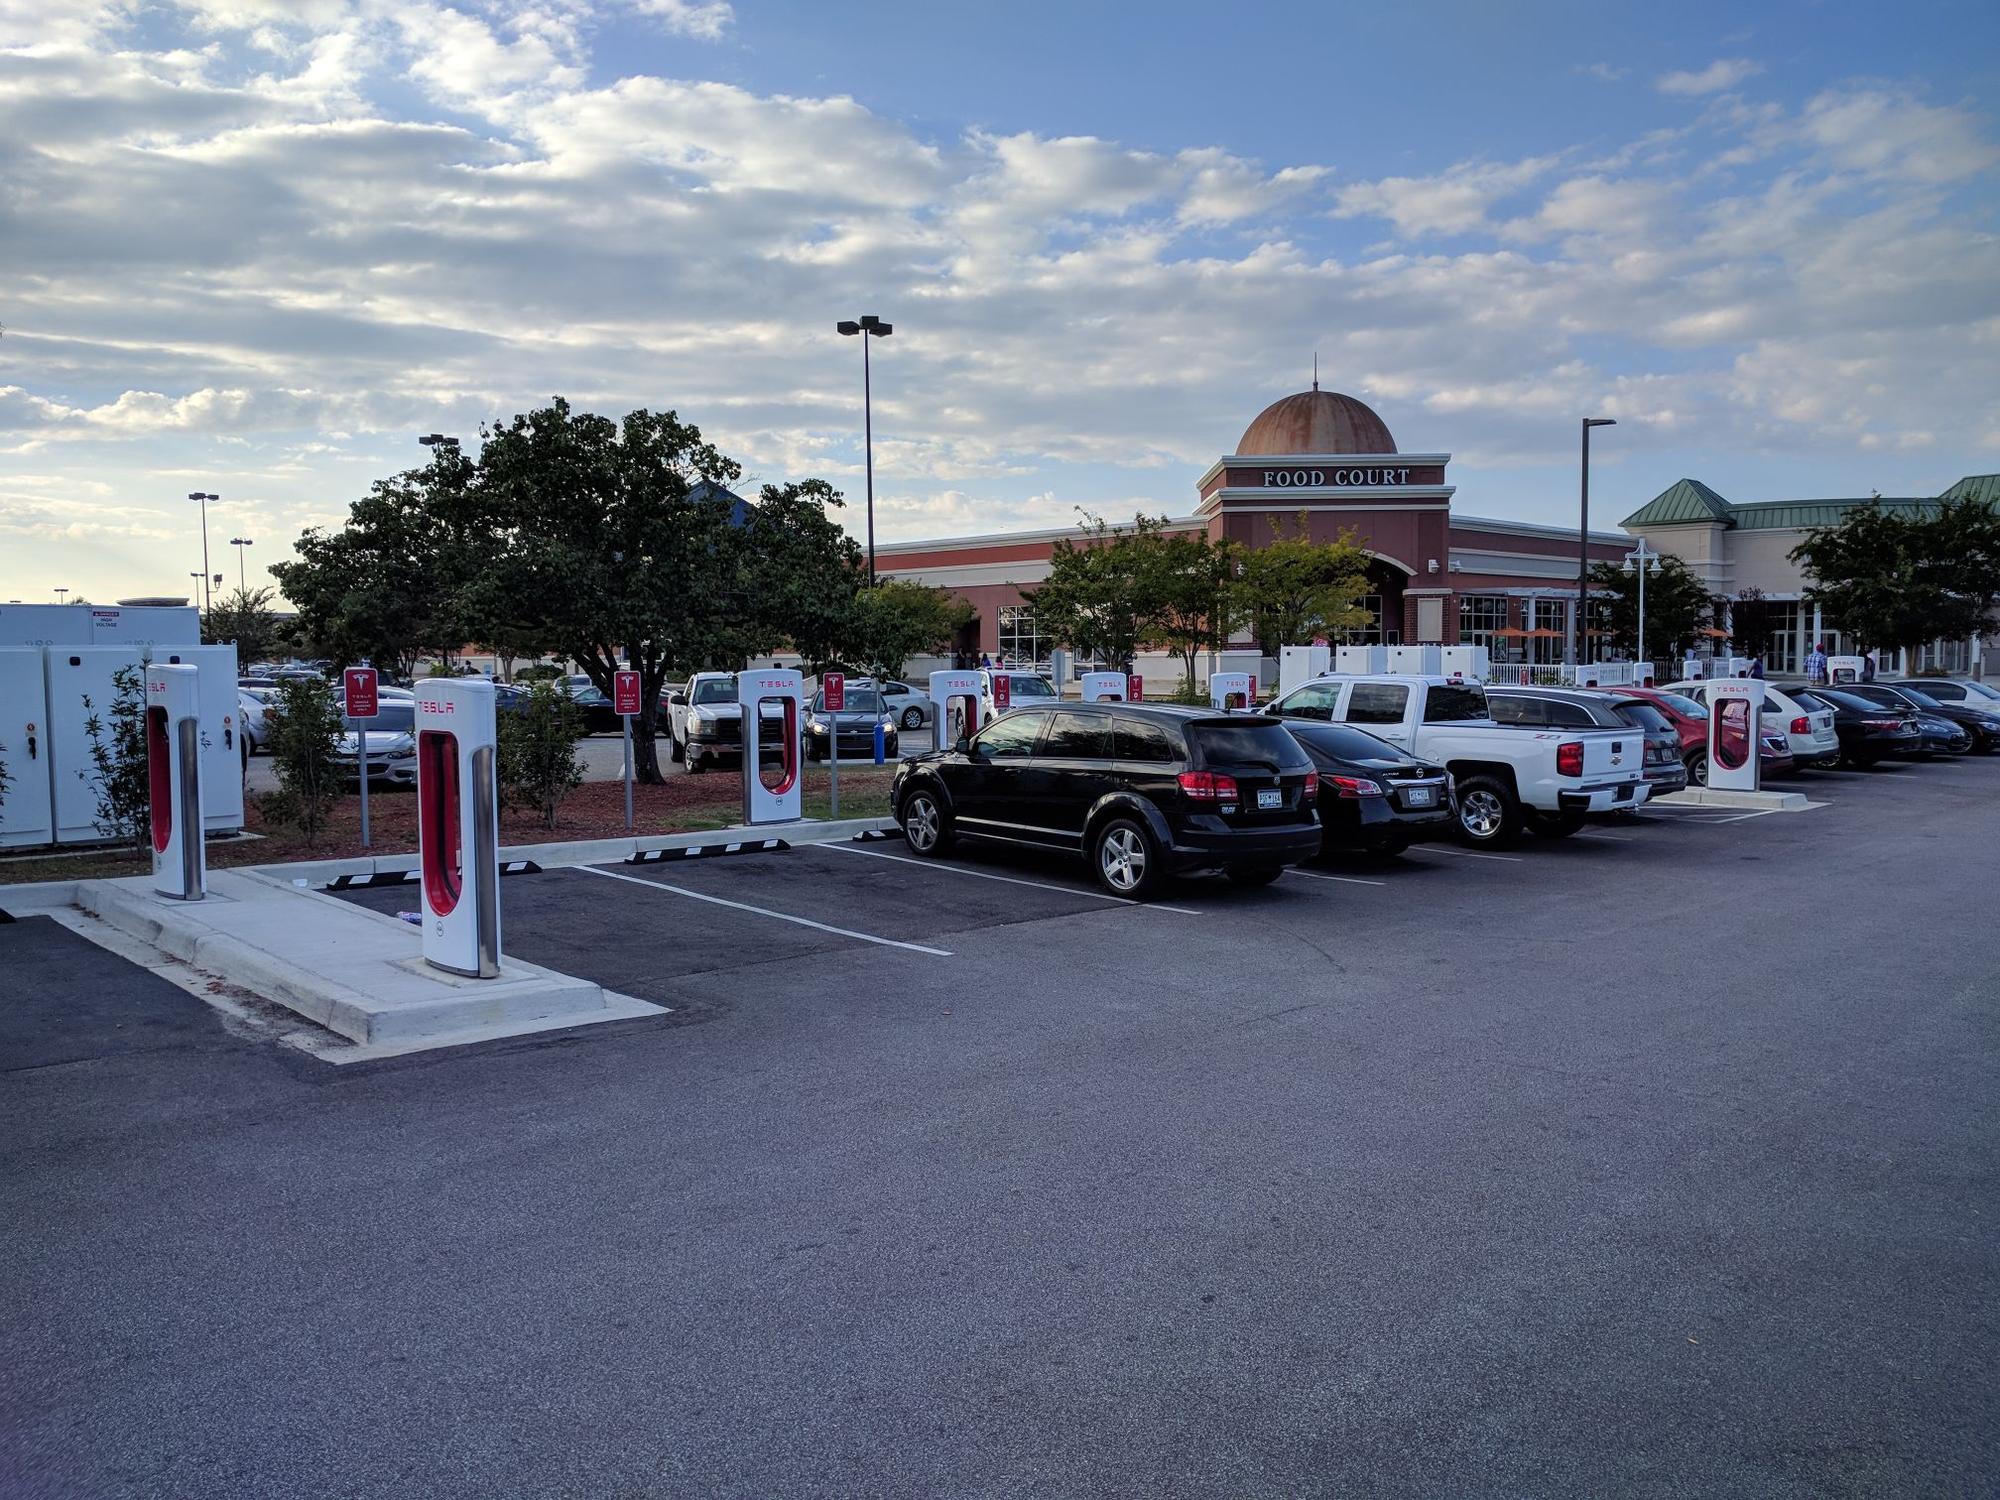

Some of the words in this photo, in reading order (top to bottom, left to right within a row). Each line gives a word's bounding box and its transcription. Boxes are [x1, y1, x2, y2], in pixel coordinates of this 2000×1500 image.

[1263, 470, 1325, 487] FOOD
[1334, 469, 1410, 485] COURT
[147, 682, 166, 692] ESLA
[418, 701, 454, 714] TESLA
